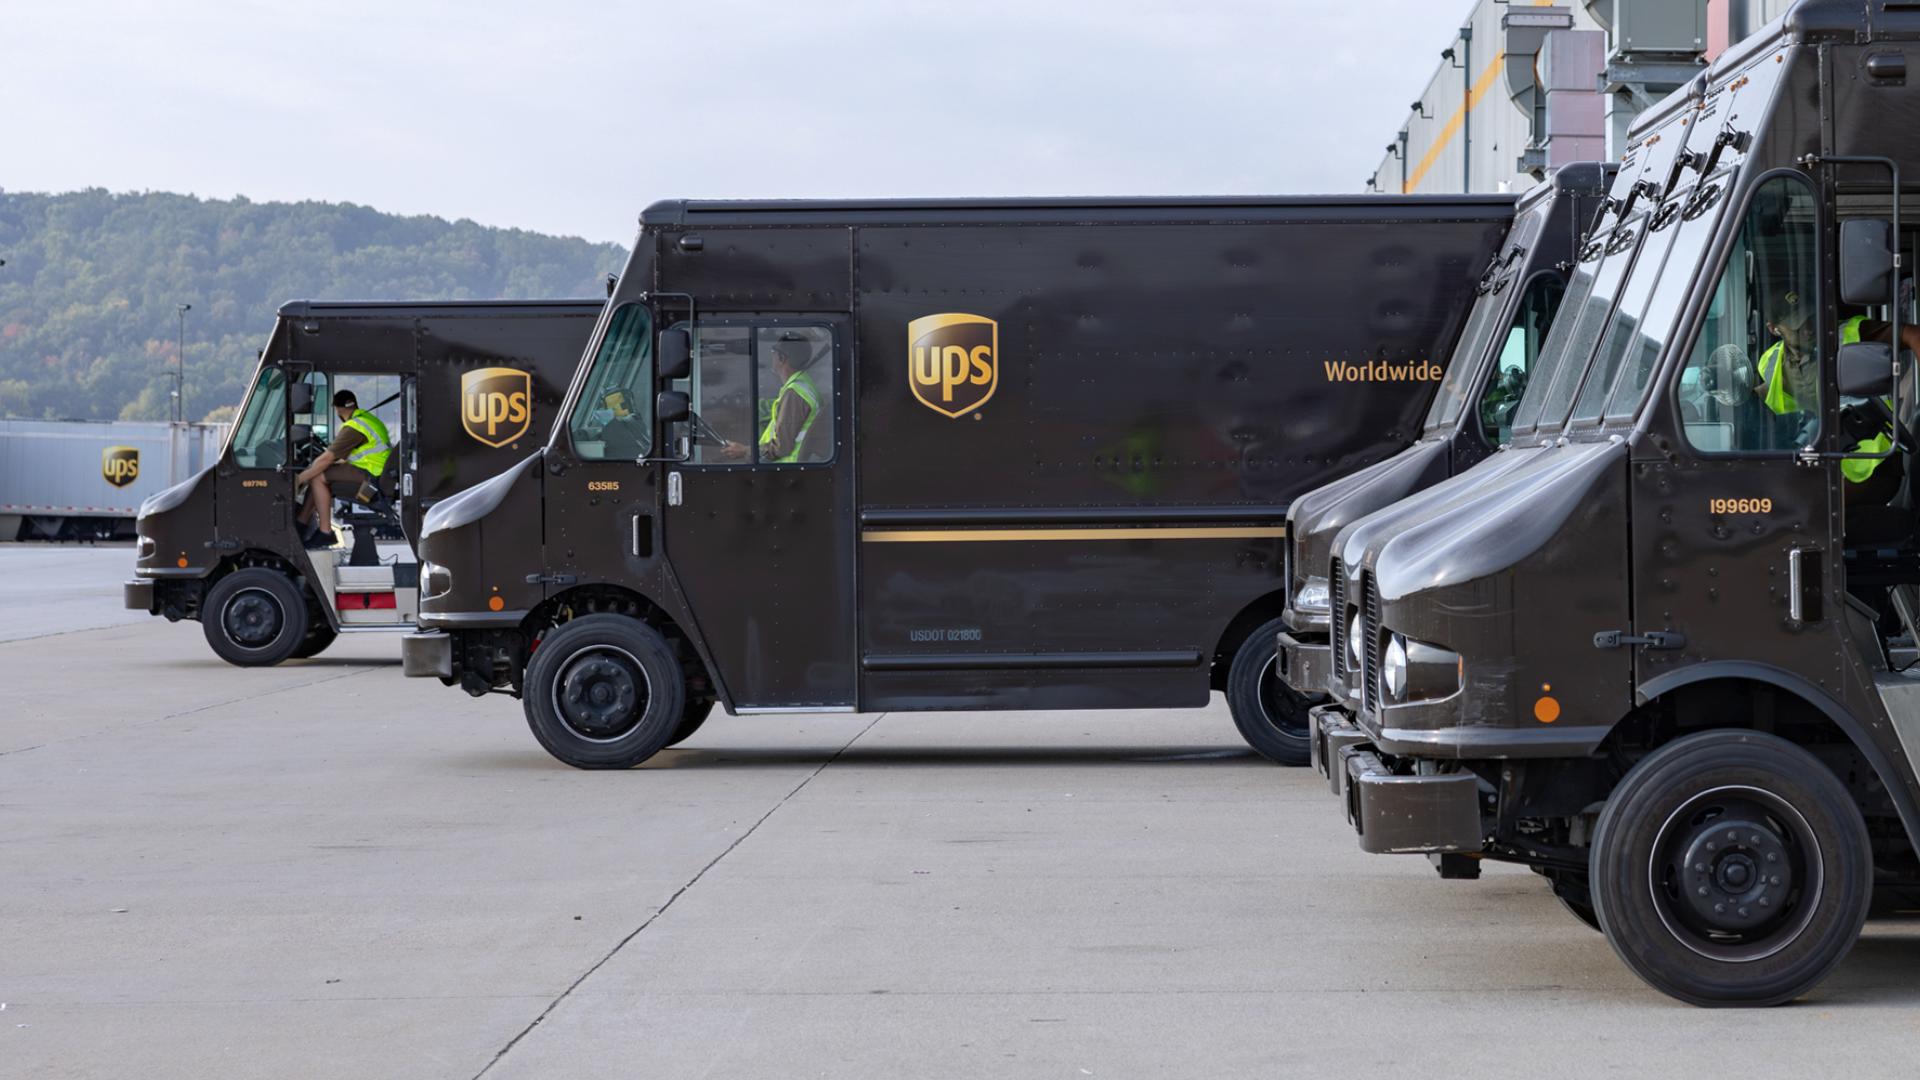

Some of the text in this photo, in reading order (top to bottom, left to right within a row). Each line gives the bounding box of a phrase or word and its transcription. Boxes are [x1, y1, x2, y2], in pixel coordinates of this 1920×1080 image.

[916, 345, 992, 402] ups
[1324, 360, 1443, 382] Worldwide
[467, 391, 527, 436] ups
[104, 457, 138, 483] ups
[1710, 498, 1772, 514] 199609
[910, 629, 982, 641] USDOT 021800
